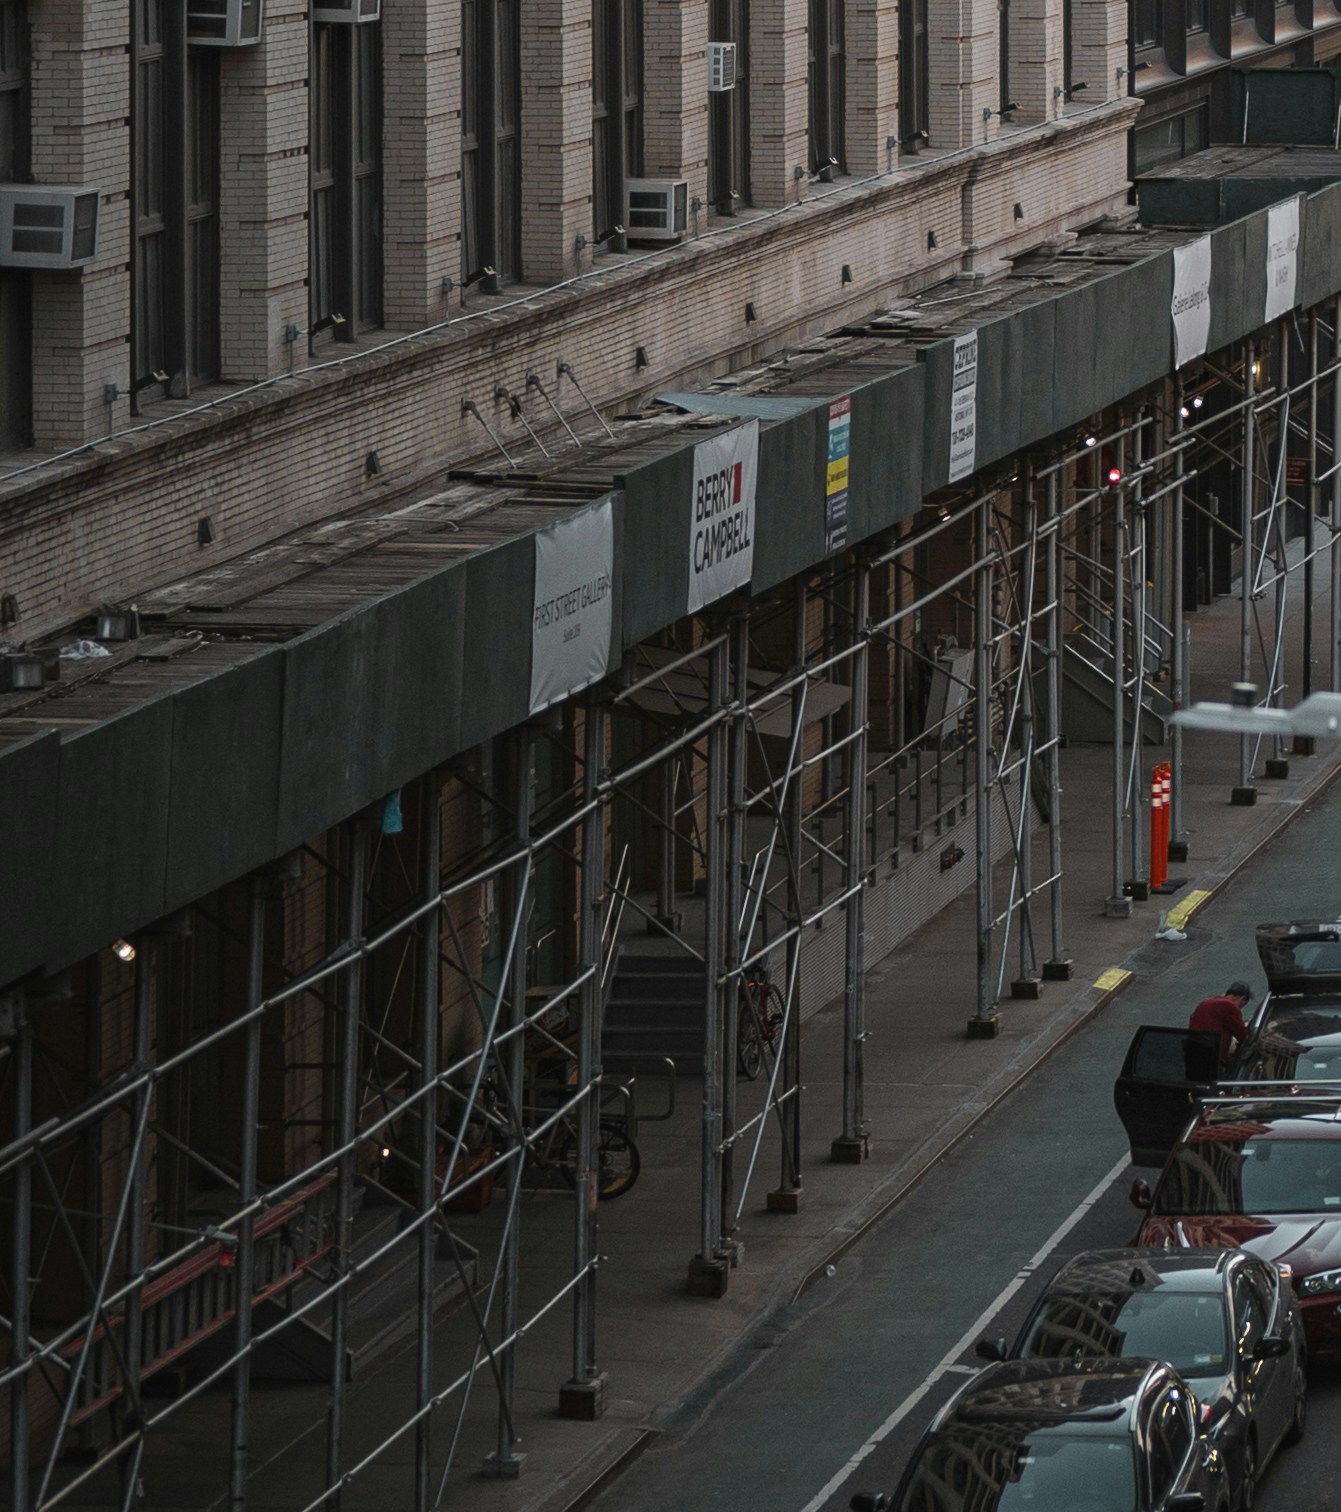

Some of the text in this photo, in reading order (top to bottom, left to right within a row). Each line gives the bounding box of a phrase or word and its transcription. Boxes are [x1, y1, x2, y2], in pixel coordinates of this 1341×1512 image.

[696, 466, 733, 523] BERRY
[694, 508, 750, 574] CAMPBELL
[535, 598, 555, 630] FIRST
[555, 586, 581, 621] STREET
